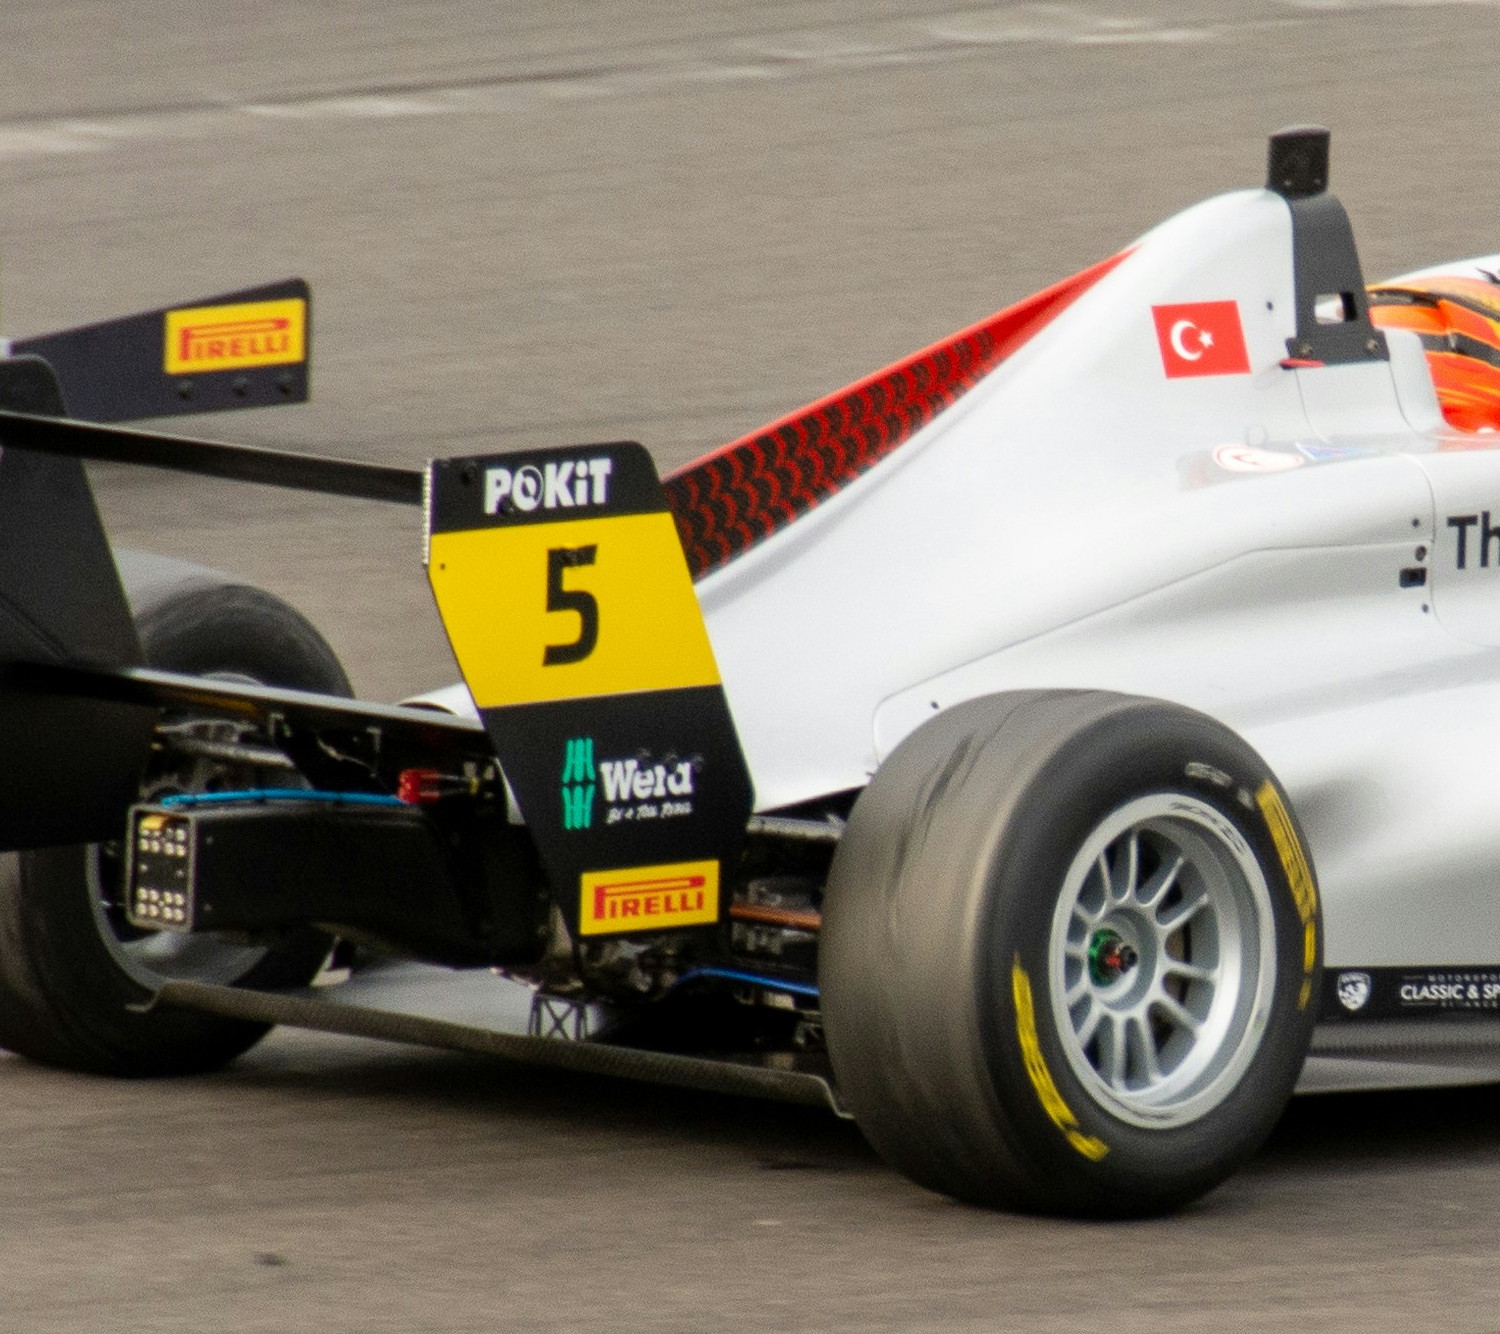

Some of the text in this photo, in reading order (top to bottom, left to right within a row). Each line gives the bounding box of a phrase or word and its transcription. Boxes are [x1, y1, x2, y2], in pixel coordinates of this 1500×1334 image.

[180, 318, 289, 361] PIRELLI
[541, 544, 599, 667] 5
[594, 875, 706, 921] PIRELLI
[1400, 985, 1464, 1000] CLASSIC
[1467, 984, 1480, 999] &
